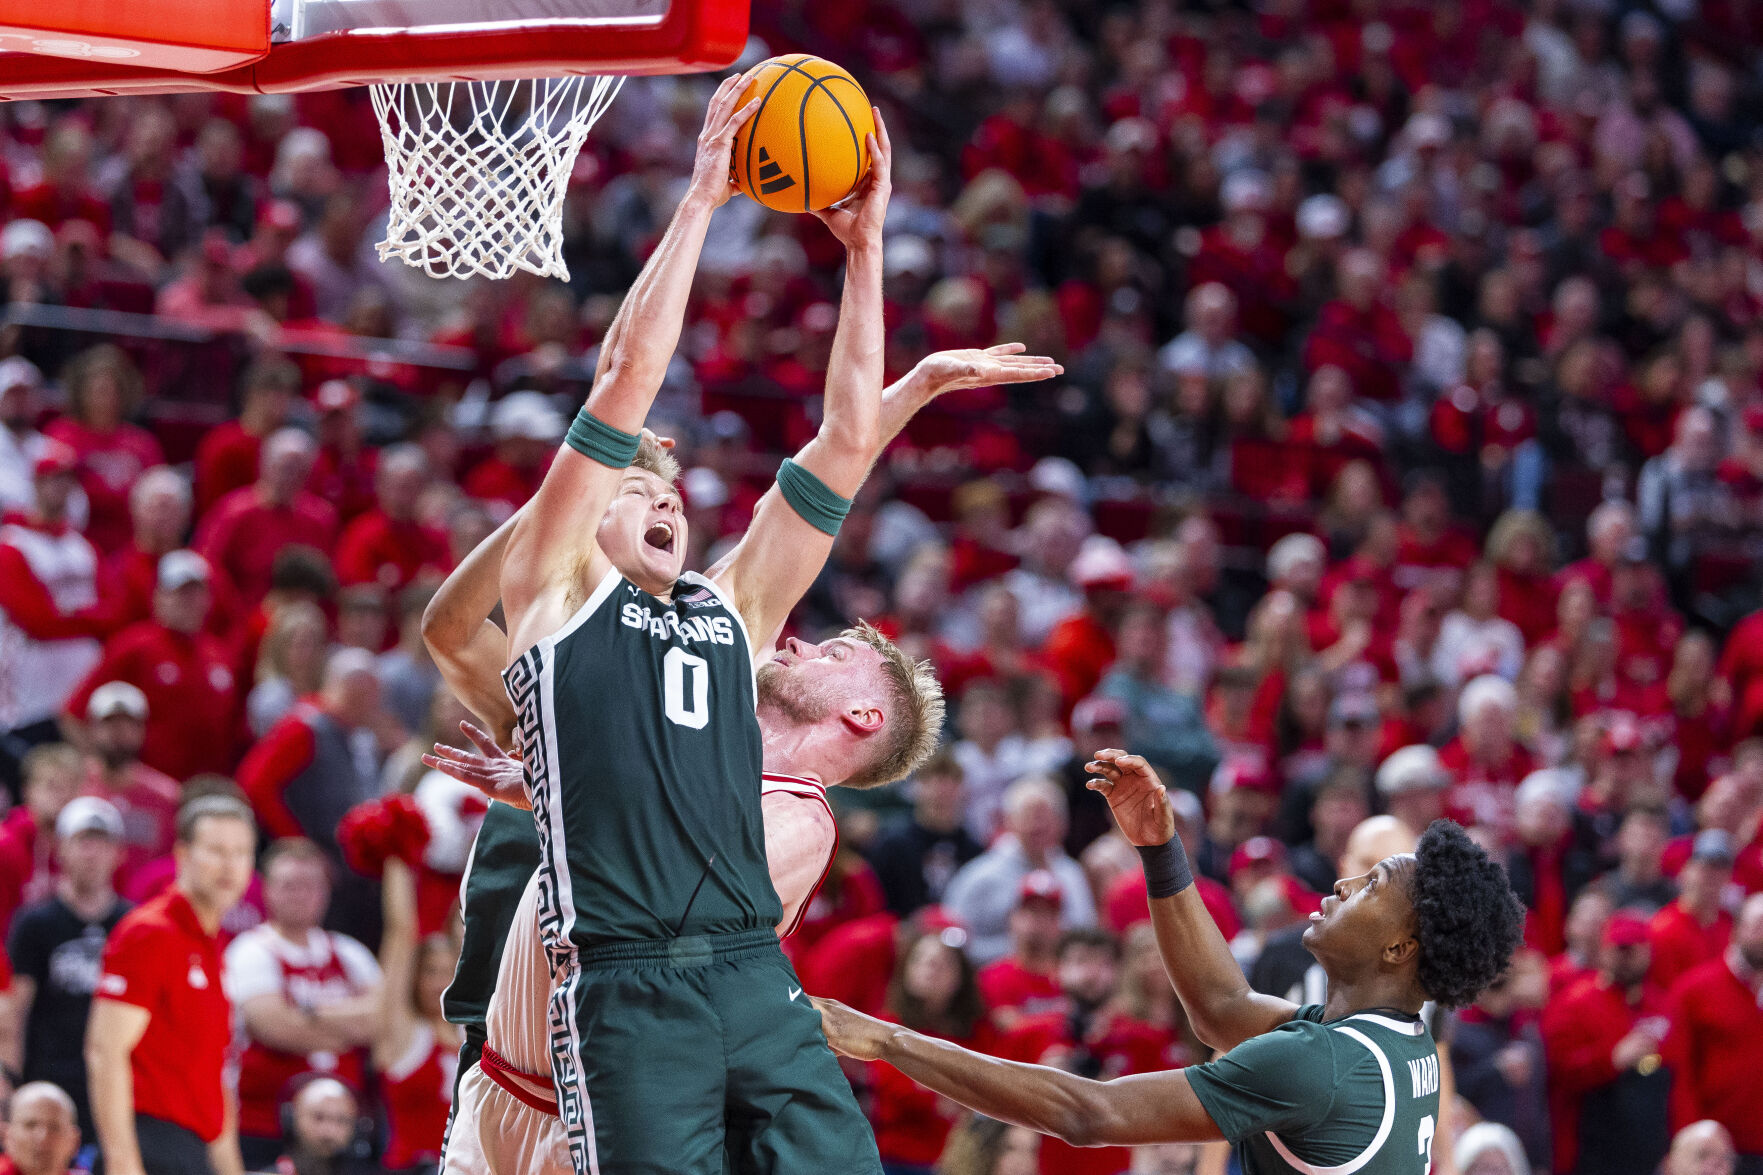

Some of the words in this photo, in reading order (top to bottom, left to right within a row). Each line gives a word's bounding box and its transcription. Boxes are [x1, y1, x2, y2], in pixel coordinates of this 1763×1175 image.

[621, 603, 734, 645] SPARANS
[663, 646, 709, 729] 0
[1407, 1054, 1439, 1098] WARD
